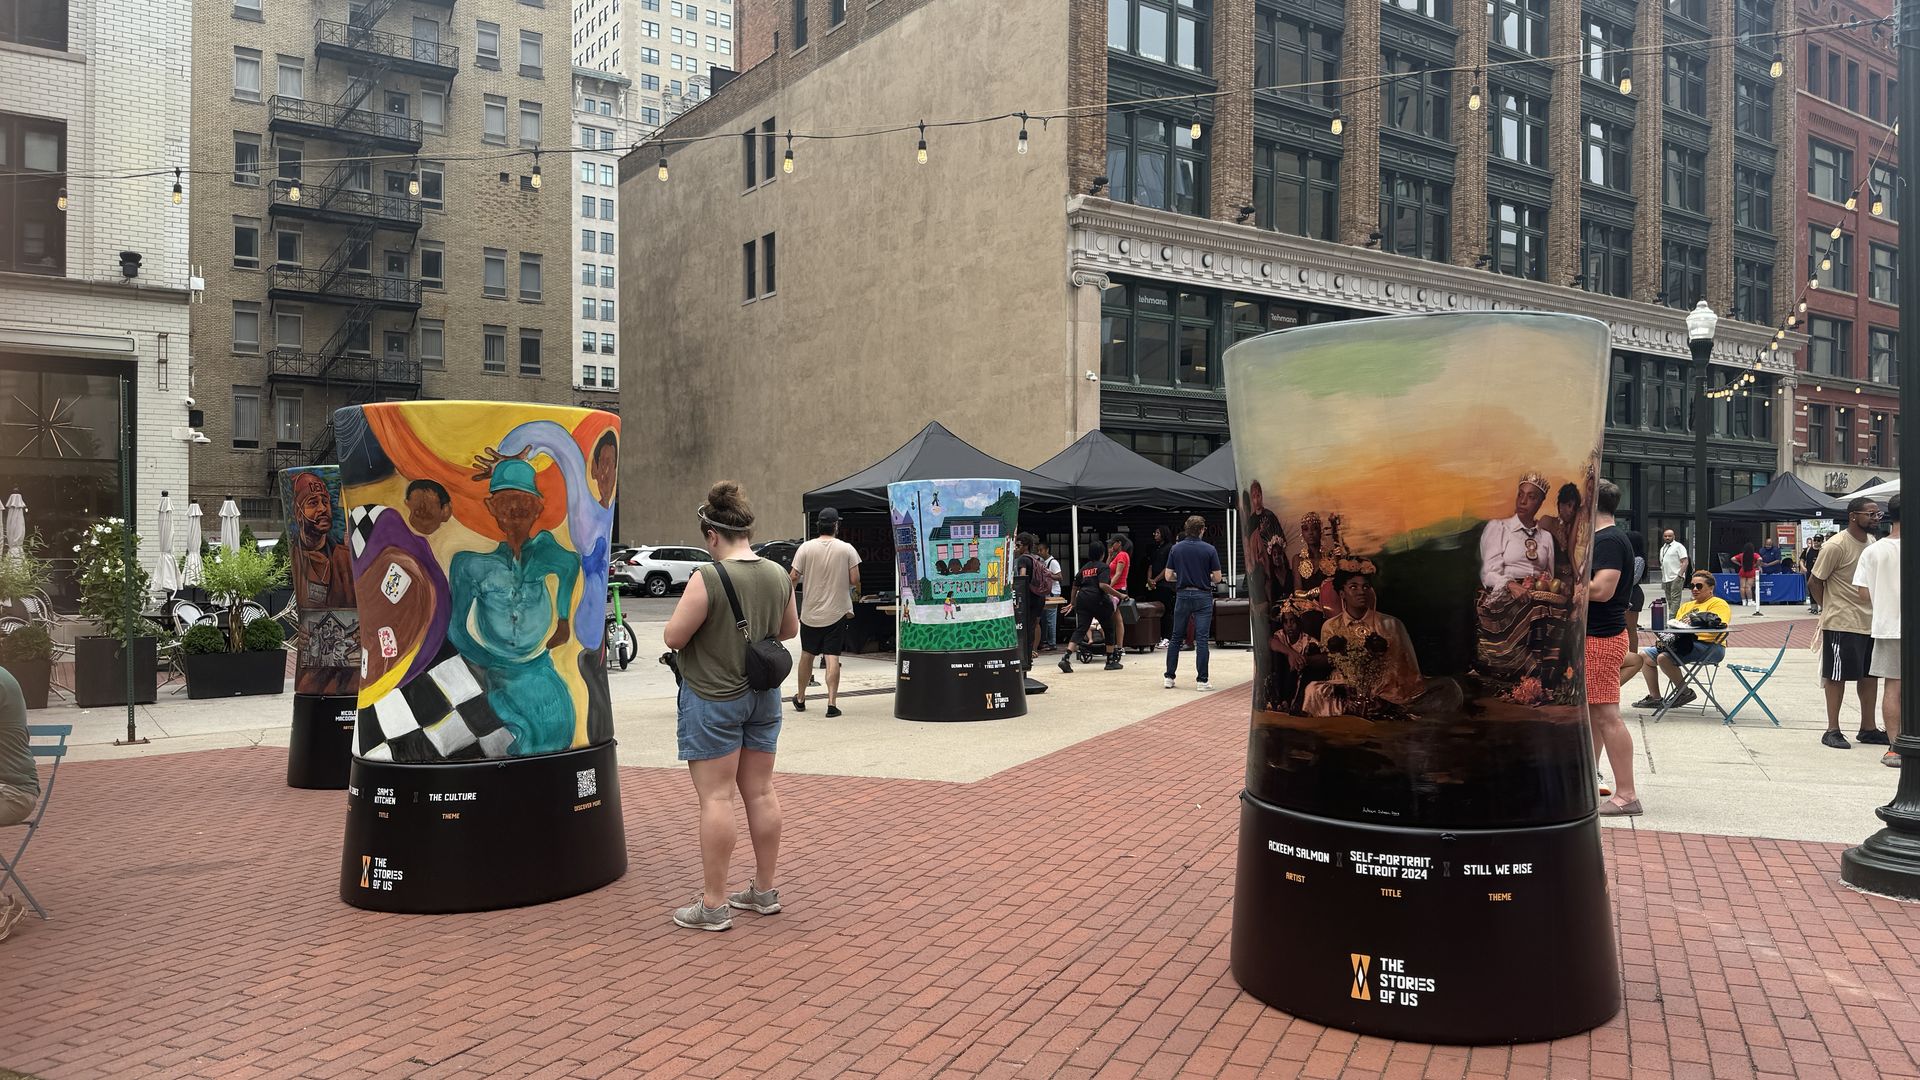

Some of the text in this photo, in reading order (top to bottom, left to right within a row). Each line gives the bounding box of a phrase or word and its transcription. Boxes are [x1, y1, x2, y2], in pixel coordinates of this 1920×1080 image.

[377, 787, 394, 797] SAM'S
[429, 792, 477, 802] THE CULTURE
[374, 796, 396, 805] KITCHEN
[442, 812, 460, 820] THEME
[1268, 840, 1330, 863] ACKEEM SALMON
[374, 857, 387, 868] THE
[1350, 850, 1434, 869] SELF-PORTRAIT,
[373, 868, 403, 880] STORIES
[1355, 863, 1428, 880] DETROIT 2024
[1463, 863, 1533, 876] STILL WE RISE
[1285, 871, 1306, 883] ARTIST
[372, 879, 393, 891] OF US
[1380, 888, 1402, 898] TITLE
[1488, 893, 1512, 901] THEME
[1379, 957, 1404, 973] THE
[1379, 973, 1435, 992] STORIES
[1380, 989, 1418, 1007] OF US
